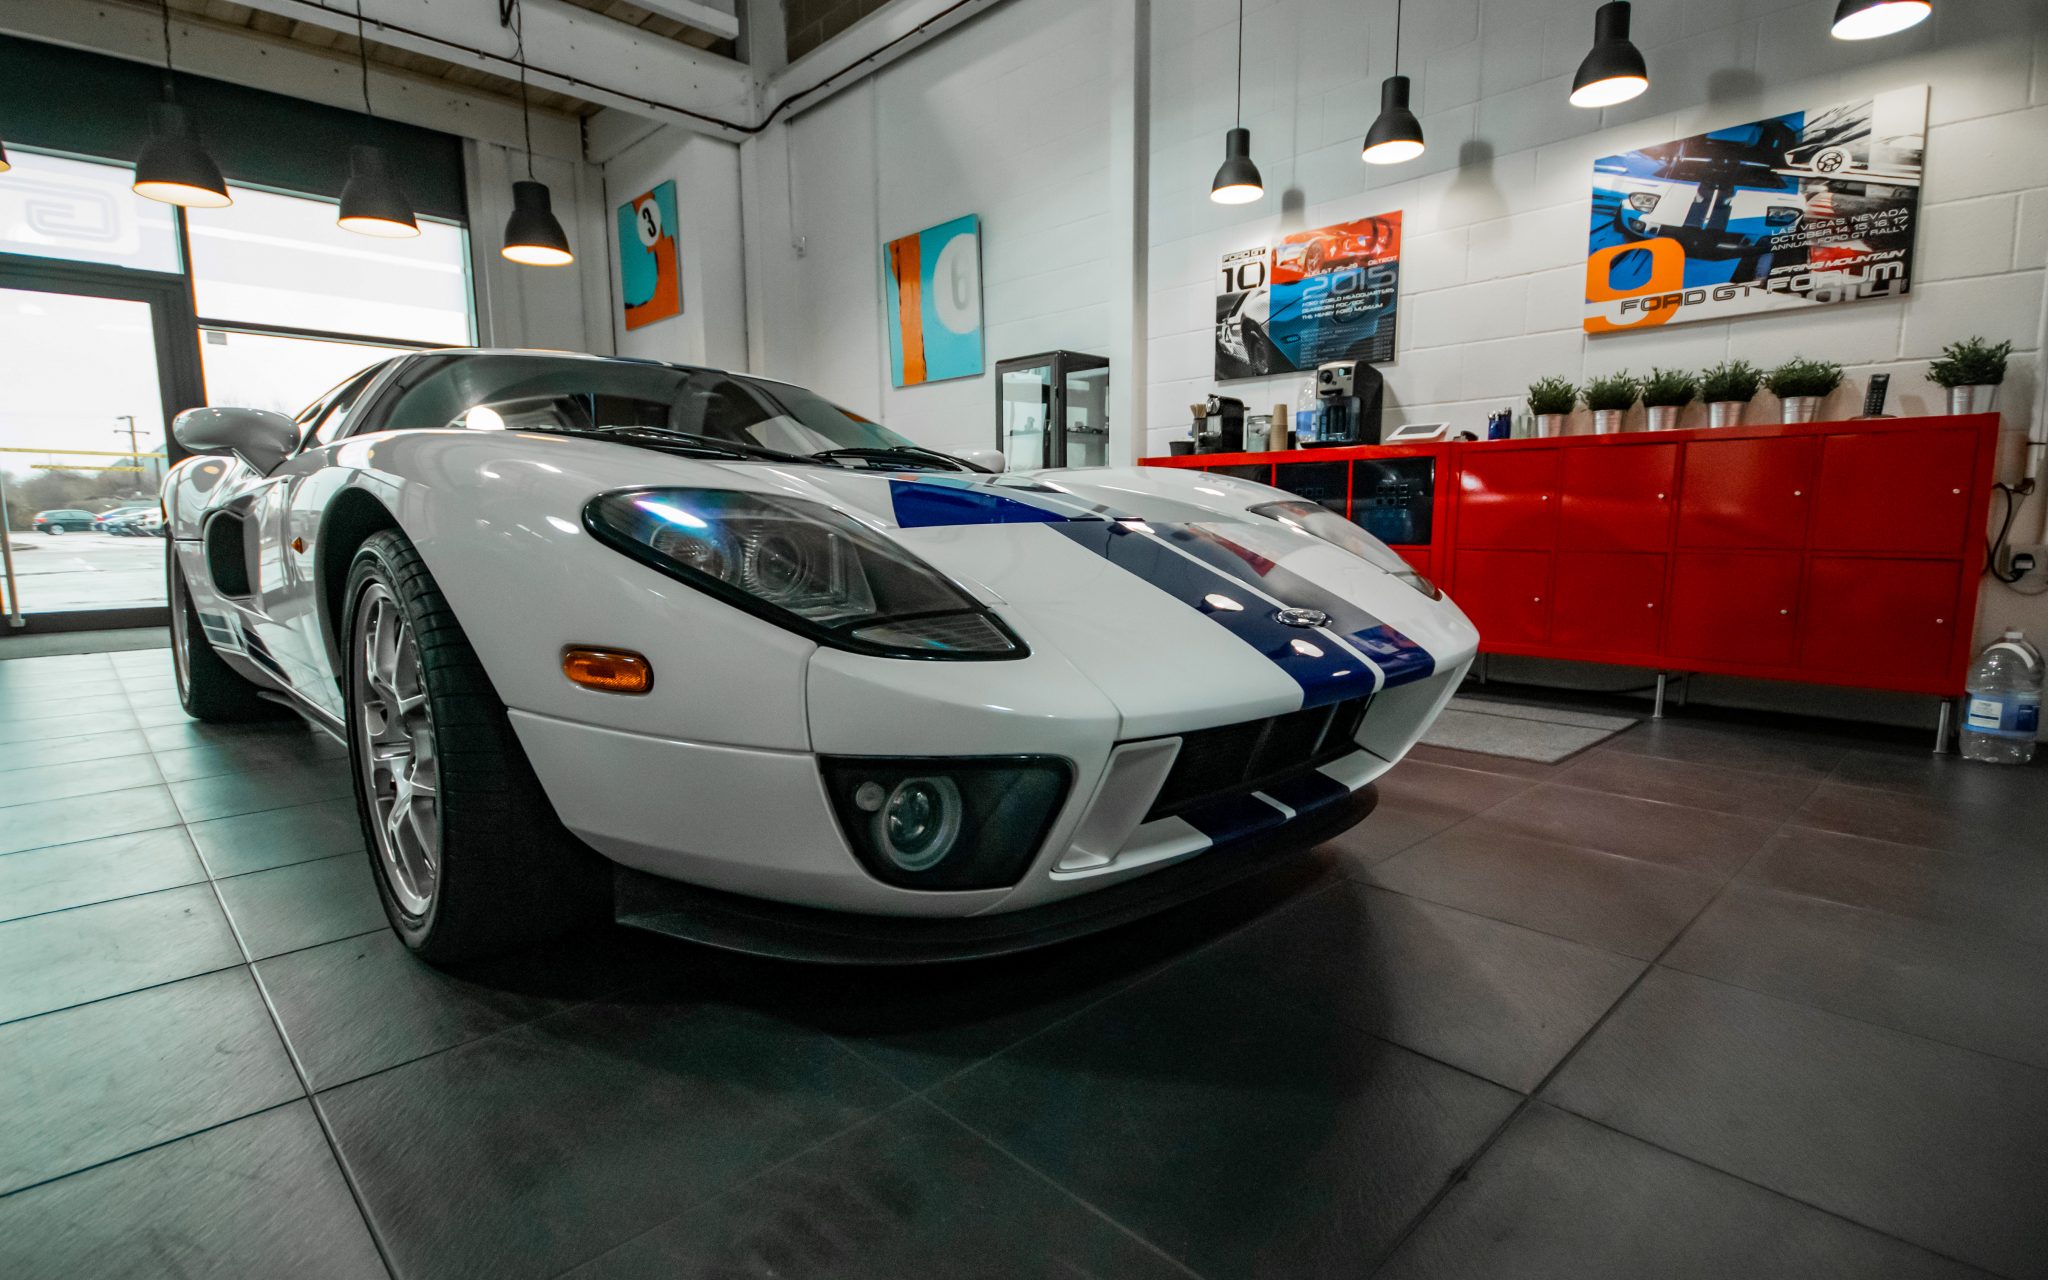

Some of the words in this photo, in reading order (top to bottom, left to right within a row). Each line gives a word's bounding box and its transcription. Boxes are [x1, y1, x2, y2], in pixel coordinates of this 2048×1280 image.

[642, 207, 657, 238] 3
[1770, 229, 1832, 244] OCTOBER
[1894, 215, 1909, 224] 17
[1771, 225, 1797, 236] LAS
[1851, 208, 1908, 222] NEVADA
[1770, 240, 1812, 252] ANNUAL
[1817, 234, 1849, 245] FORD
[1851, 230, 1868, 239] GT
[1869, 224, 1909, 236] RALLY
[1367, 256, 1397, 267] DETROIT
[1770, 261, 1823, 275] SPRING
[1825, 249, 1905, 268] MOUNTAIN
[1221, 261, 1266, 293] 10
[1302, 265, 1397, 301] 2015
[1620, 289, 1706, 315] FORD
[1712, 280, 1762, 302] GT
[1766, 261, 1904, 293] FORUM
[1343, 288, 1395, 300] HEADQUARTERS
[1314, 310, 1334, 318] HENRY
[1353, 302, 1384, 312] MUSEUM
